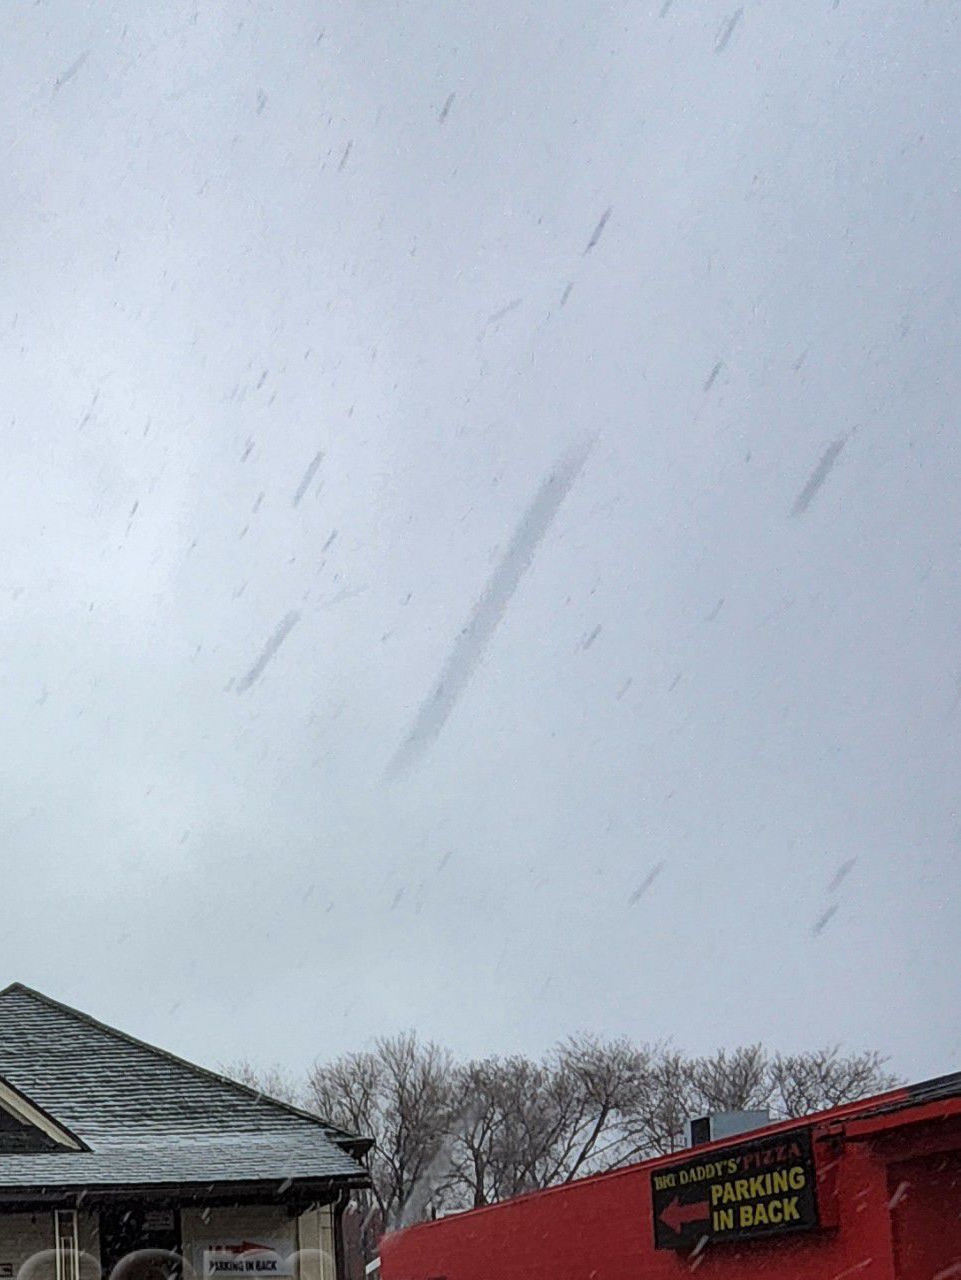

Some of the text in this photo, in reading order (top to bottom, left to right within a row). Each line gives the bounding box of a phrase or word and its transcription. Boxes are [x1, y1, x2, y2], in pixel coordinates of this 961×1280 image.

[711, 1166, 806, 1205] PARKING
[713, 1196, 801, 1232] IN BACK
